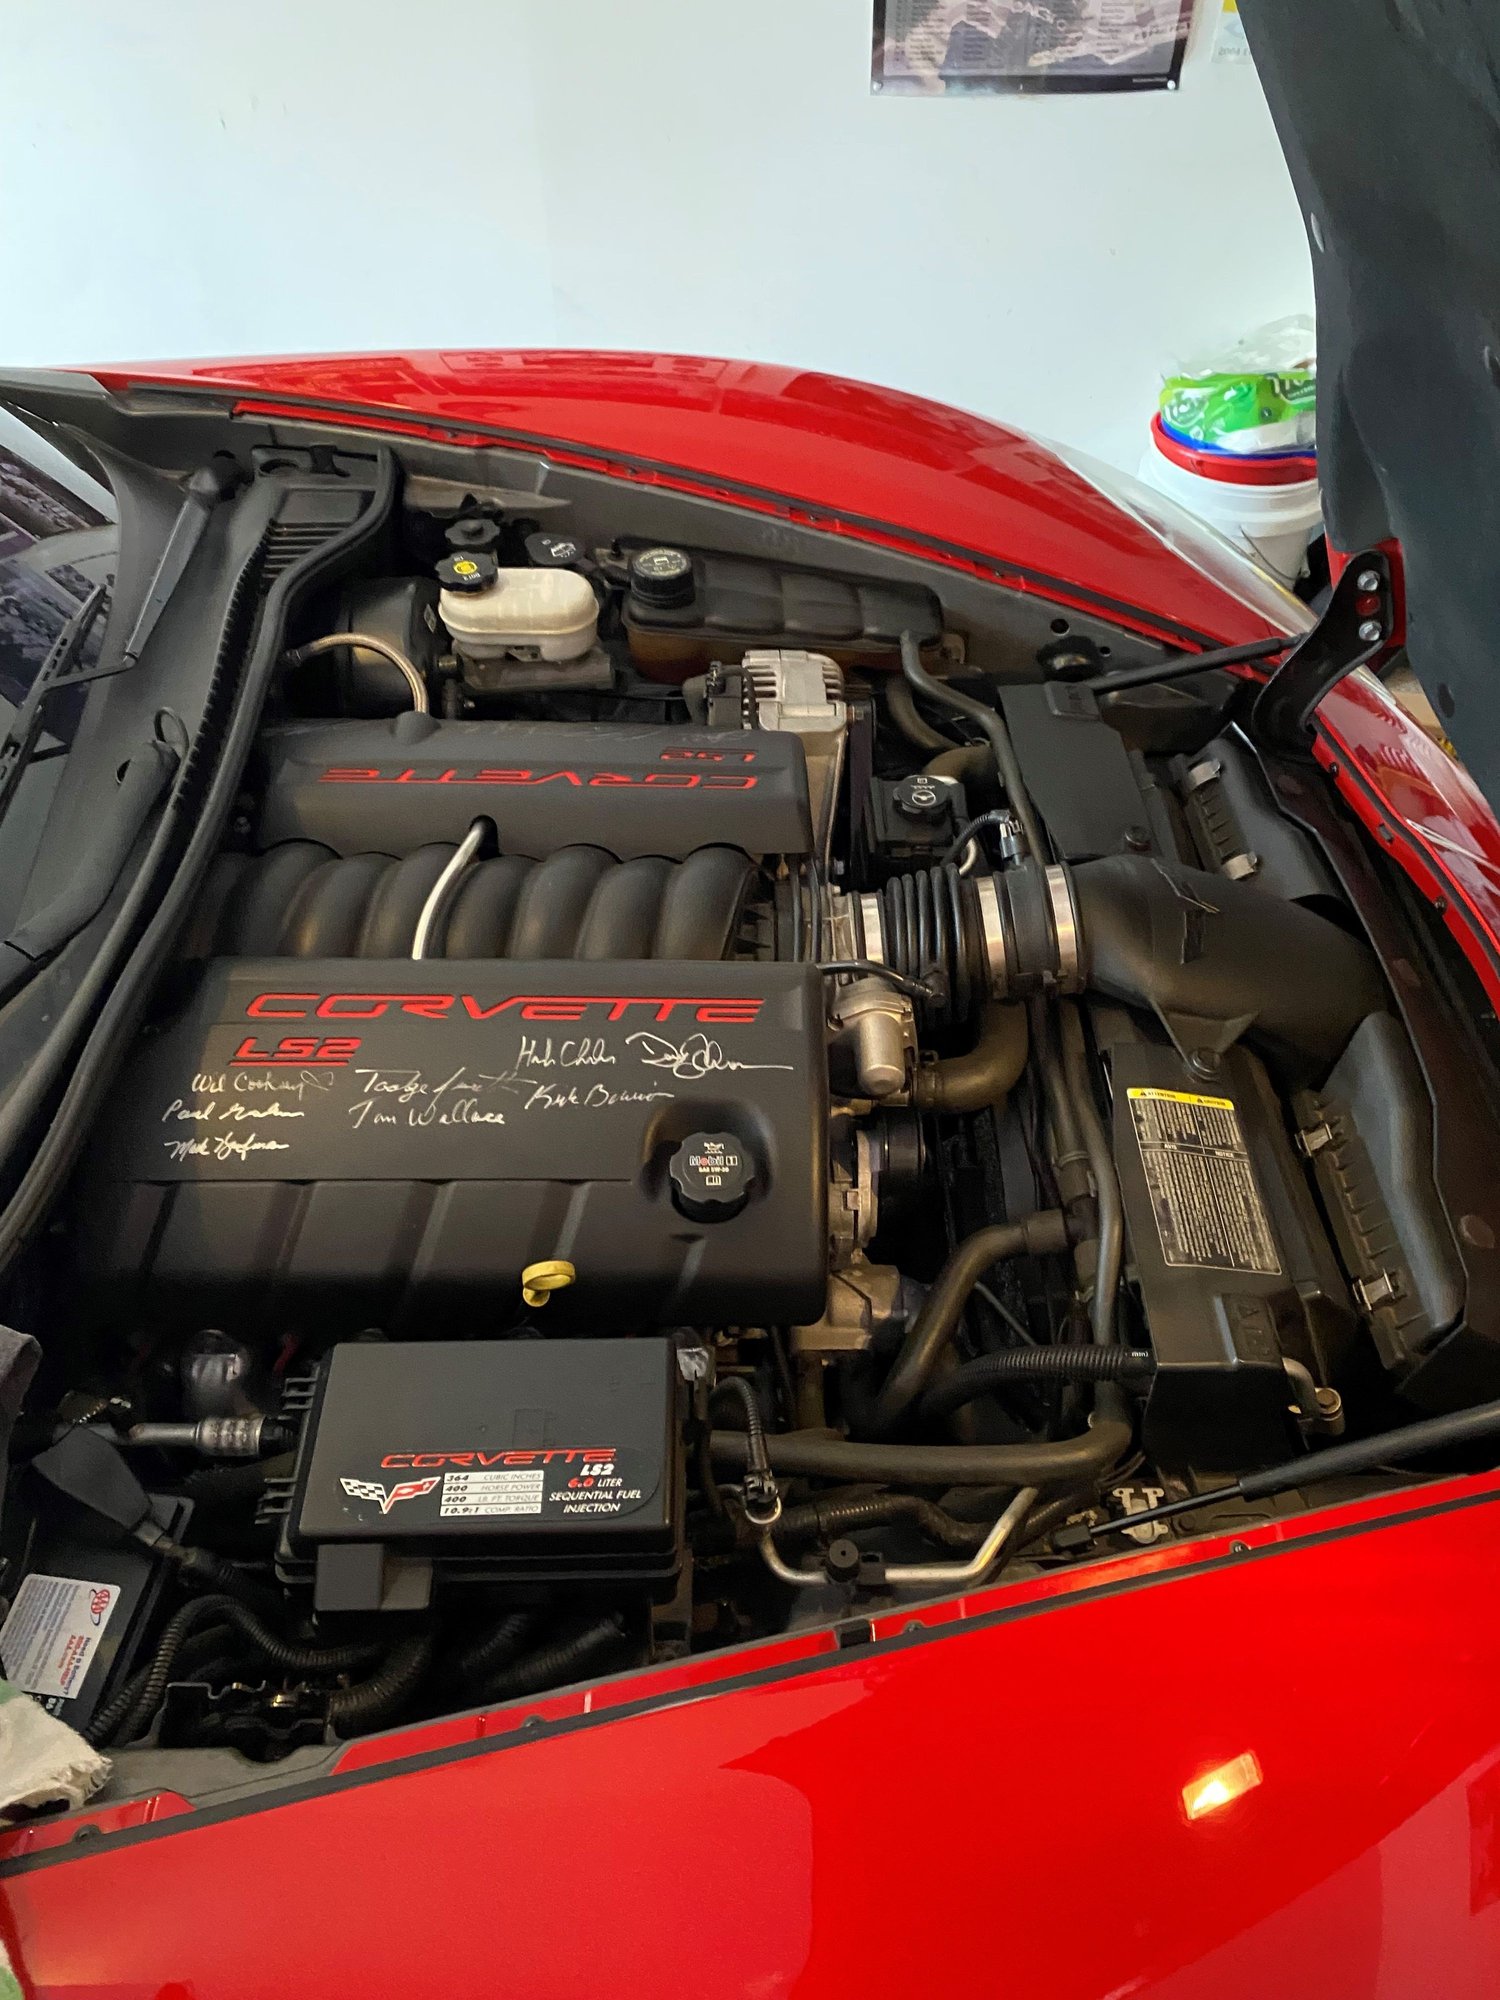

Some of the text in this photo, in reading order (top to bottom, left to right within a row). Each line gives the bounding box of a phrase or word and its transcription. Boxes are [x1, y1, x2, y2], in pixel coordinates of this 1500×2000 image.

[319, 769, 758, 789] CORVETTE
[246, 993, 765, 1023] CORVETTE
[234, 1036, 362, 1060] LS2
[689, 1155, 724, 1166] Mobil
[381, 1448, 616, 1468] CORVETTE
[580, 1463, 615, 1476] LS2
[484, 1473, 508, 1481] CUBIC
[568, 1476, 623, 1489] 6.0 LITER
[511, 1483, 541, 1491] POWER
[444, 1495, 467, 1503] 400
[549, 1489, 642, 1502] SEQUENTIAL FUEL
[515, 1505, 539, 1513] RATIO
[563, 1502, 621, 1513] INJECTION
